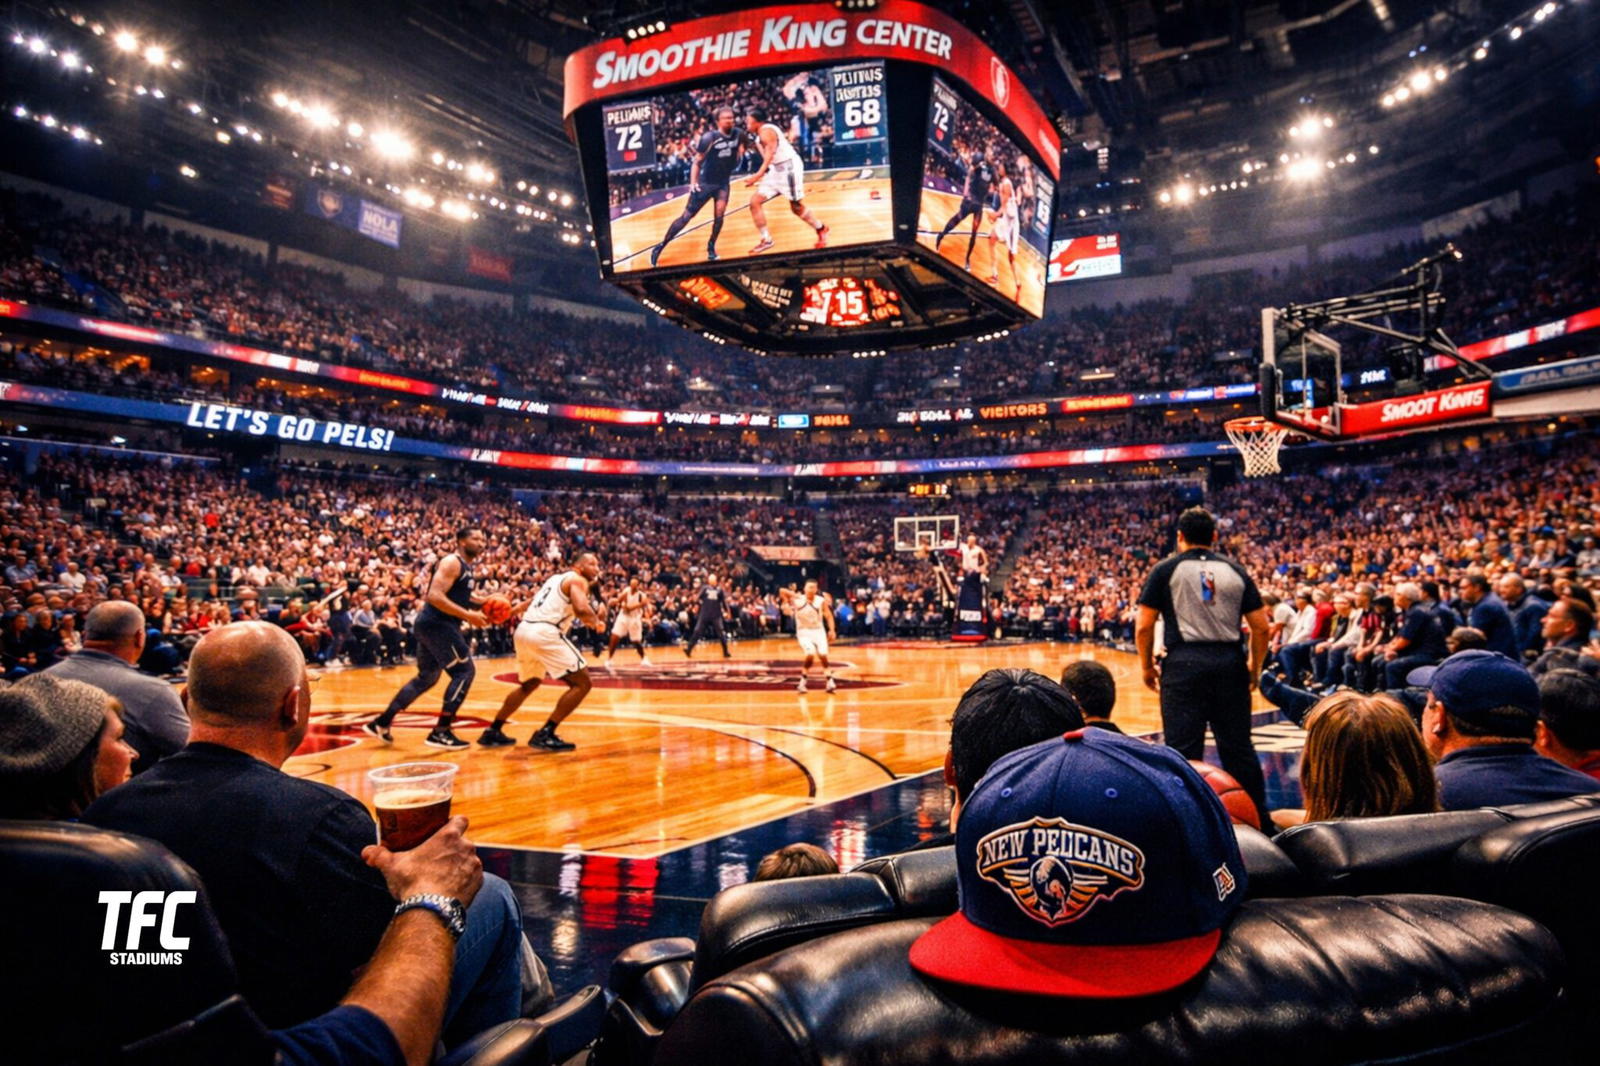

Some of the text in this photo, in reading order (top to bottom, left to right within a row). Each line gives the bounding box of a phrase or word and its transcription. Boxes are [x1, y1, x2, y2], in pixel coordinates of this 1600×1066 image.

[593, 16, 953, 88] SMOOTHIE KING CENTER
[844, 98, 881, 127] 68
[933, 101, 949, 132] 72
[615, 124, 643, 151] 72
[363, 209, 398, 232] NOLA
[835, 290, 863, 315] 15
[186, 402, 395, 451] LET'S GO PELS!
[982, 829, 1028, 867] NEW
